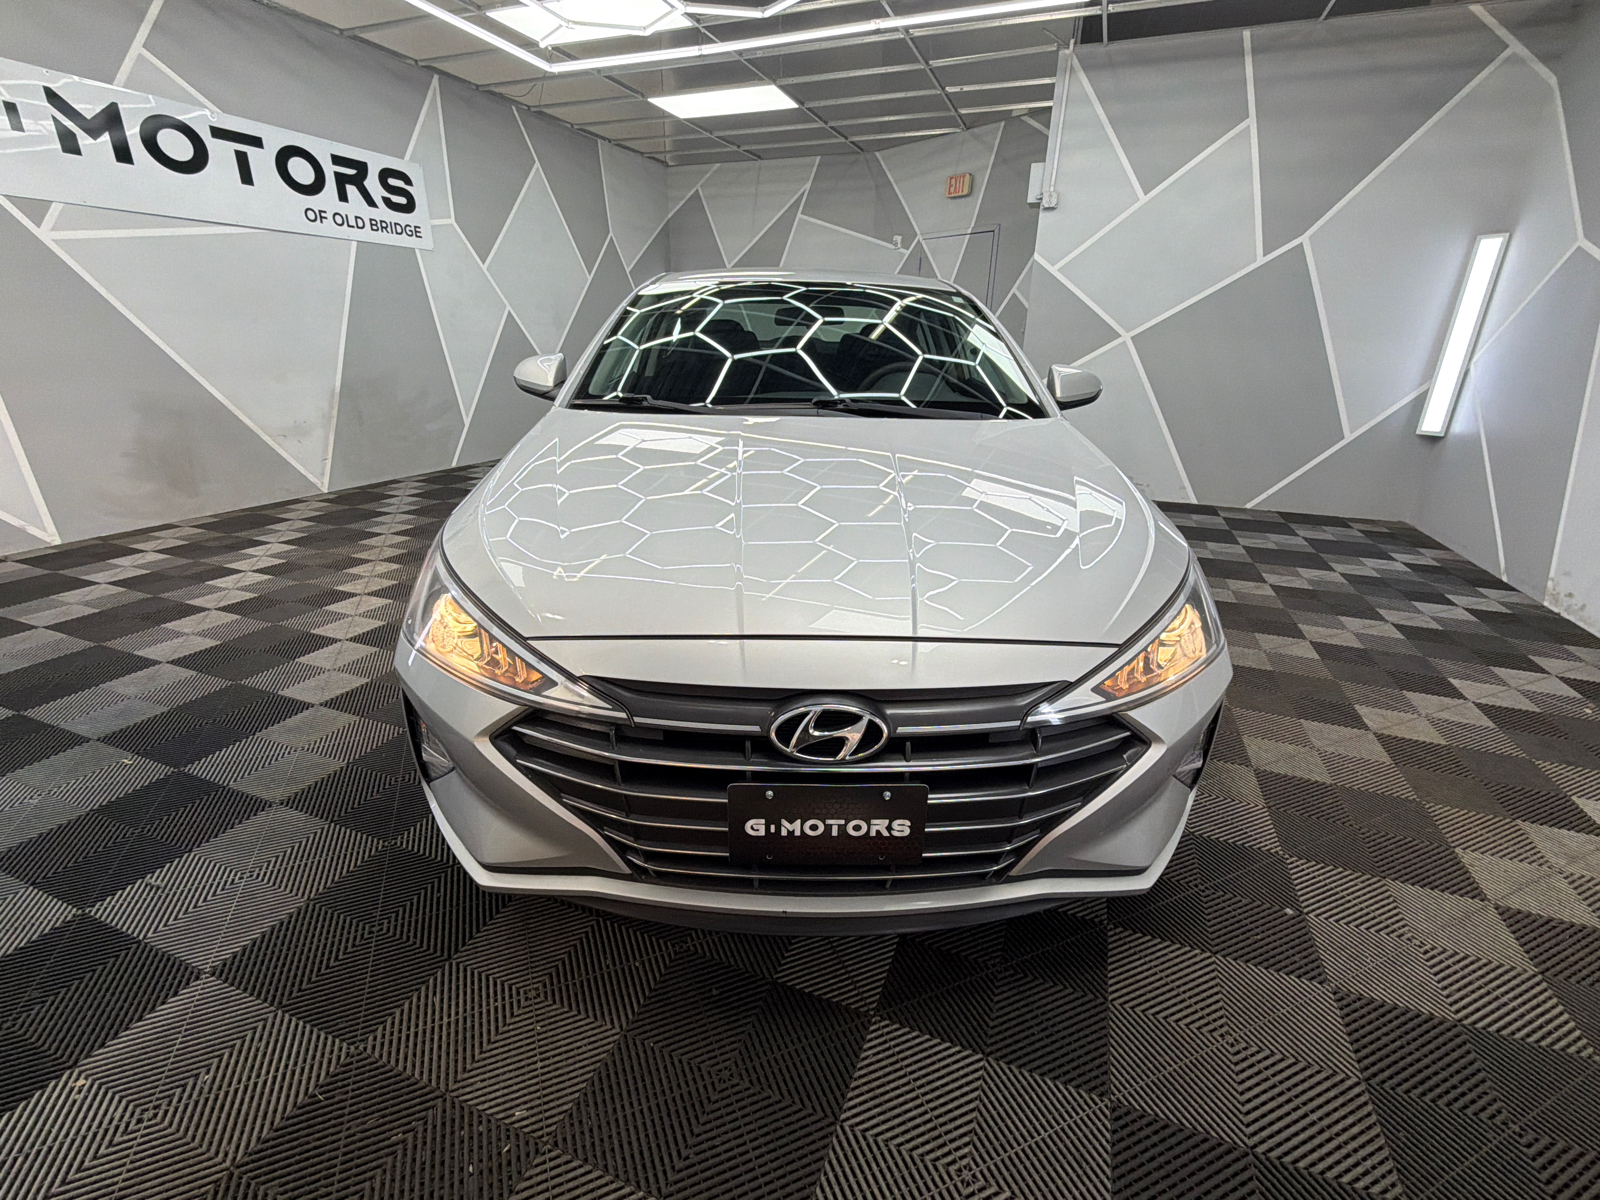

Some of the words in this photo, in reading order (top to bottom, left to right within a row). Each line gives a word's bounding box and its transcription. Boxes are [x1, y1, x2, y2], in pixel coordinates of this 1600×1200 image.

[948, 174, 967, 196] EXIT
[304, 207, 328, 224] OF
[332, 212, 365, 230] OLD
[369, 218, 423, 239] BRIDGE
